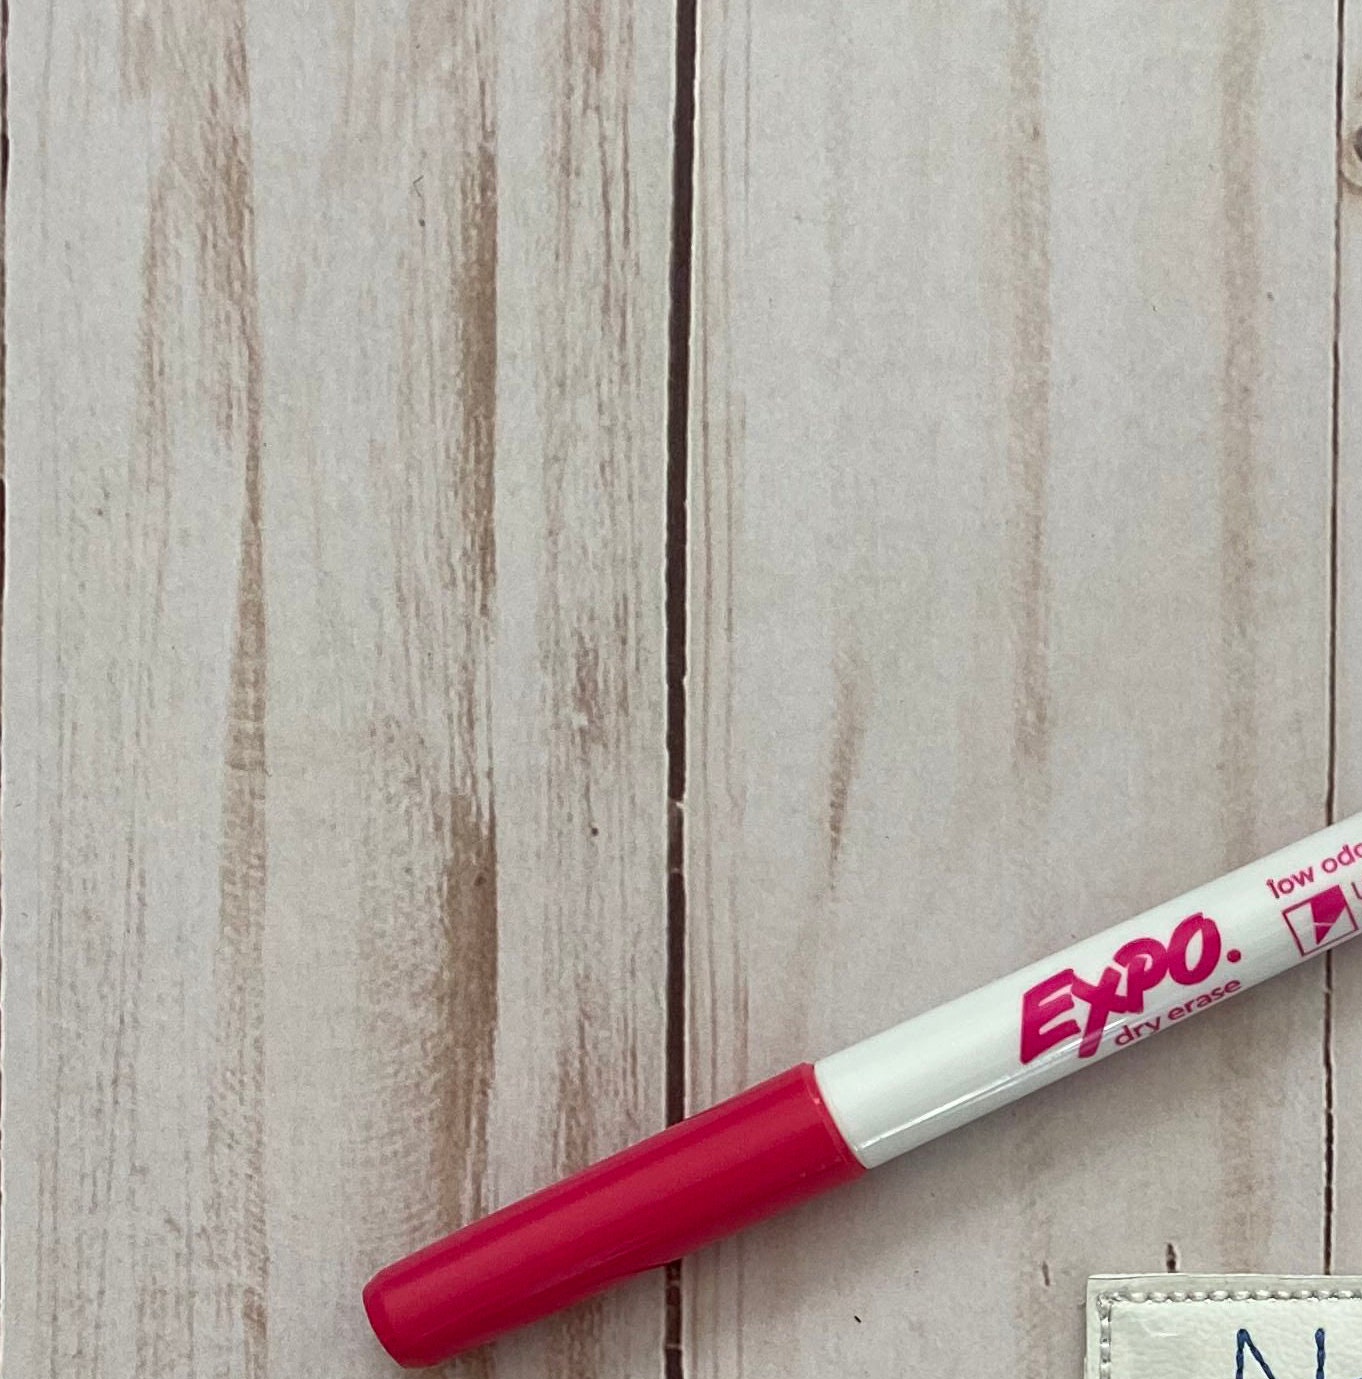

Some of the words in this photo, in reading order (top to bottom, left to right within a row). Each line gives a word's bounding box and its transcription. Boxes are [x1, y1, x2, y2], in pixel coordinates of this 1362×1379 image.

[1266, 866, 1315, 899] low
[1114, 1017, 1161, 1048] dry
[1168, 977, 1241, 1022] erase
